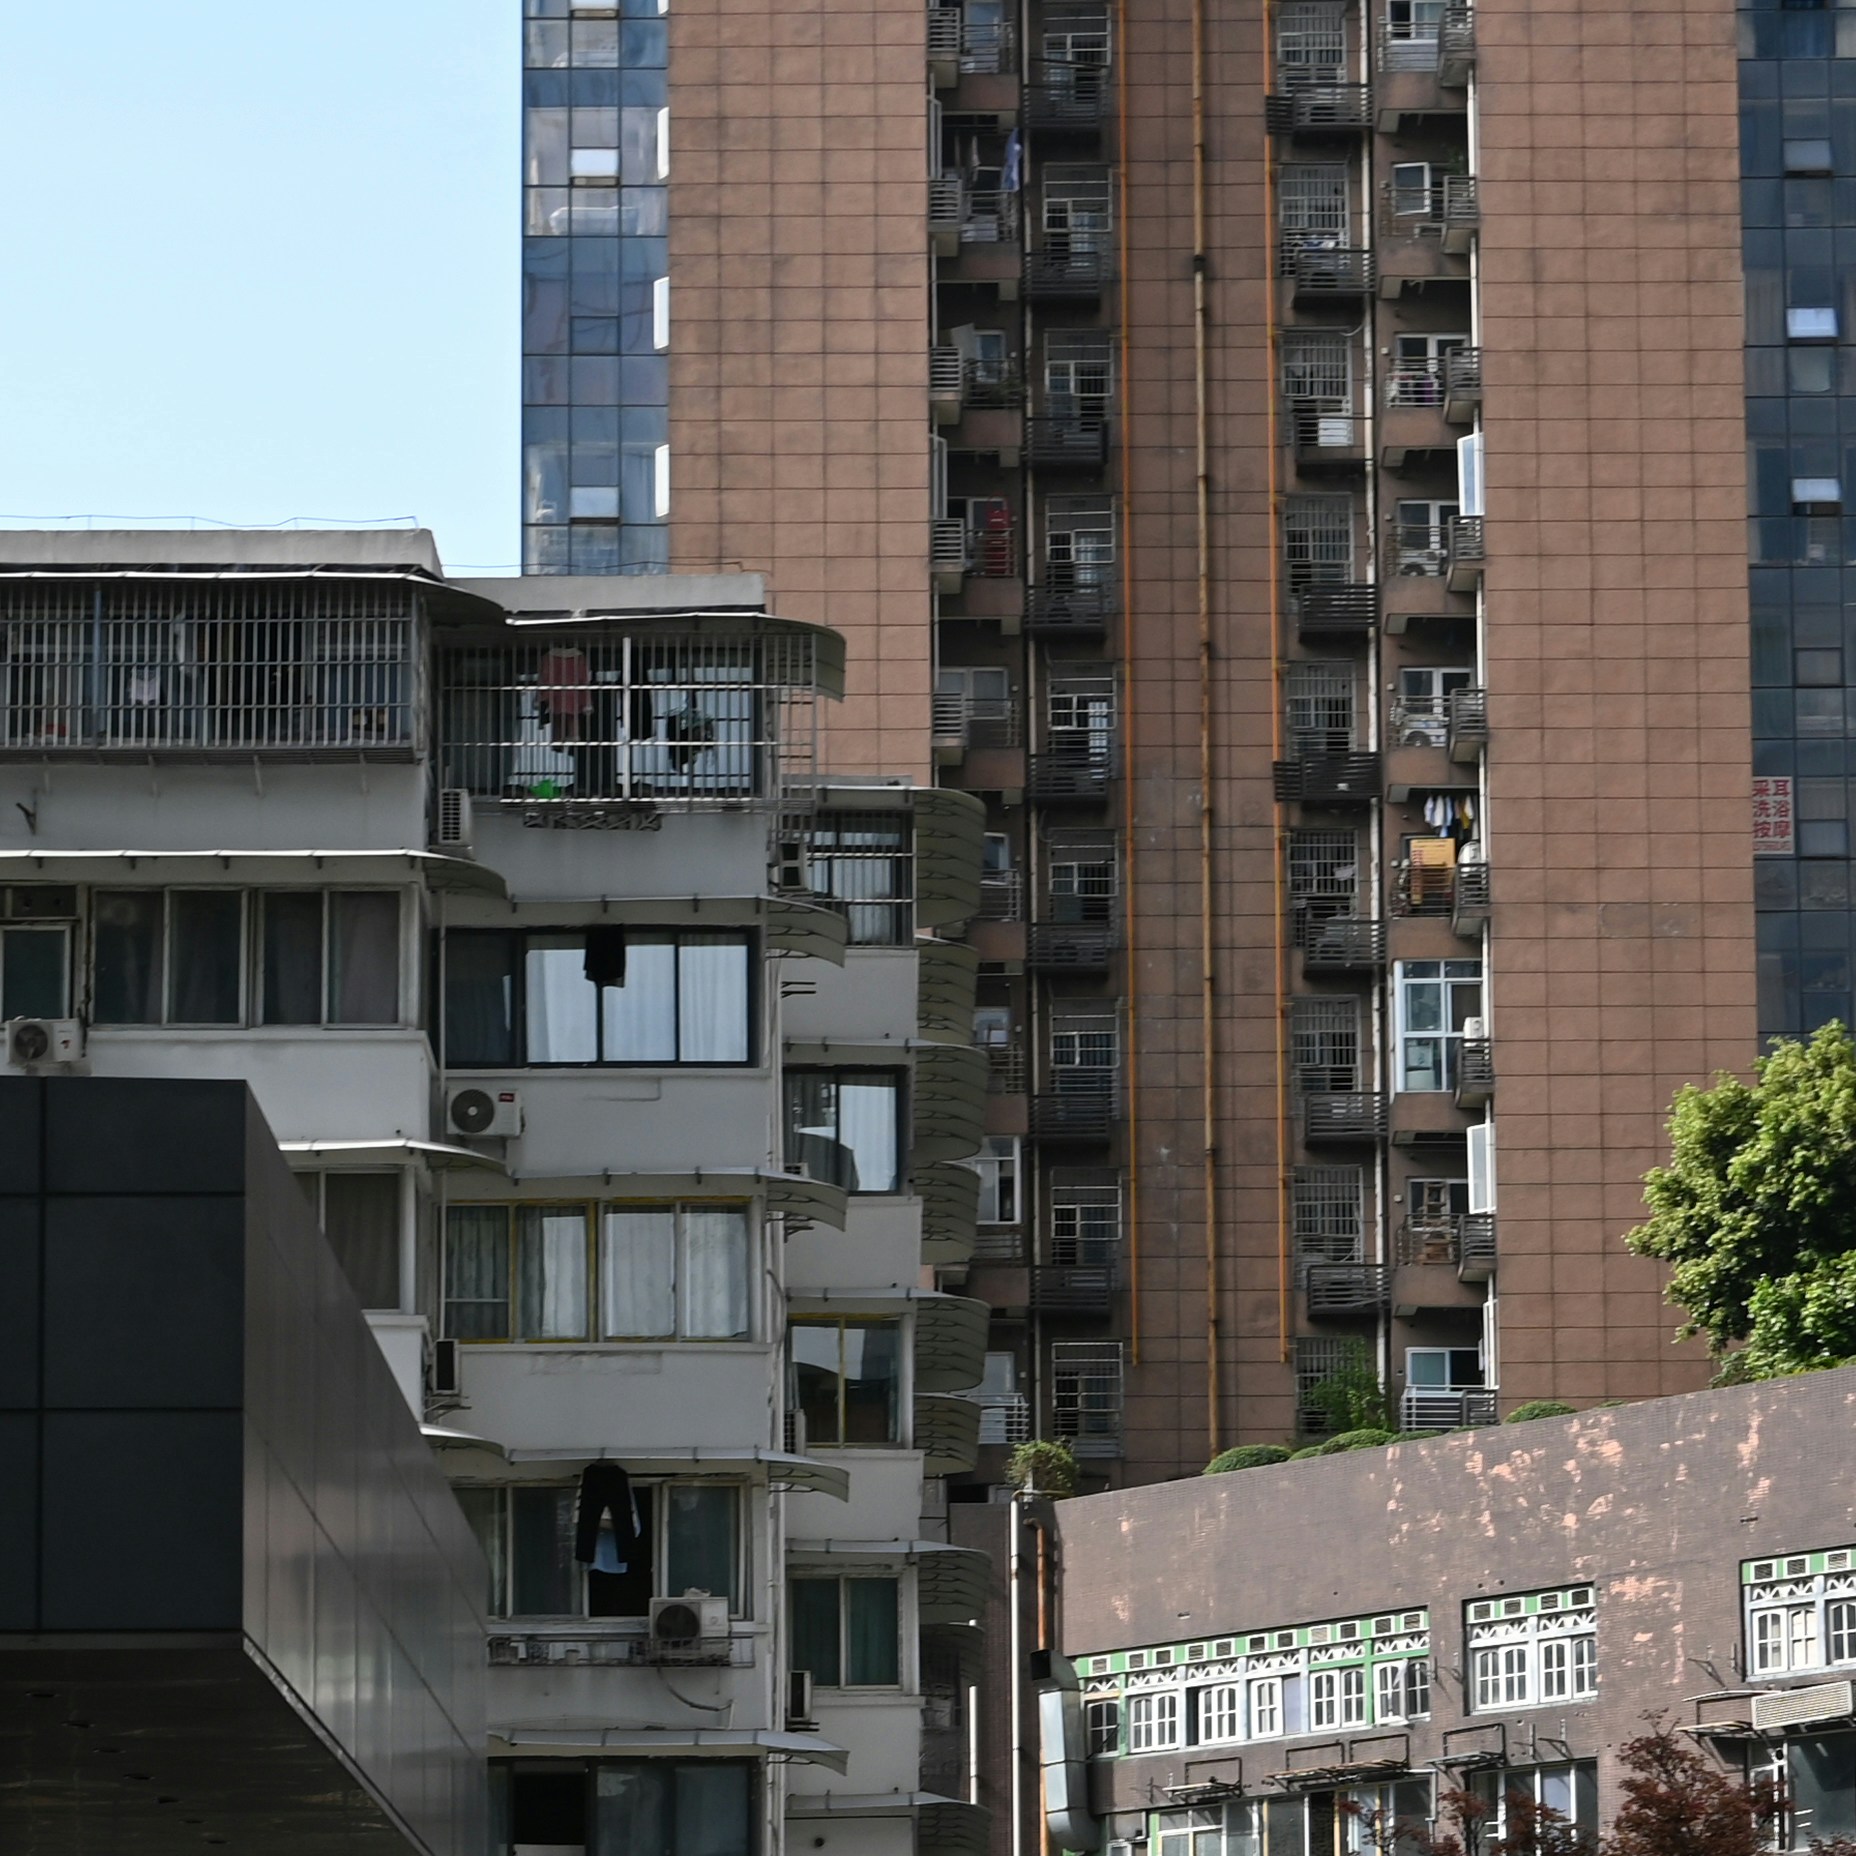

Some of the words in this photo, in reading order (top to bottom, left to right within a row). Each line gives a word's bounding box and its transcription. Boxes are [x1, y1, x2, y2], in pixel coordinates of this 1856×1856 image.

[1752, 780, 1790, 797] 采耳
[1752, 800, 1790, 818] 洗浴
[1752, 820, 1791, 838] 按摩
